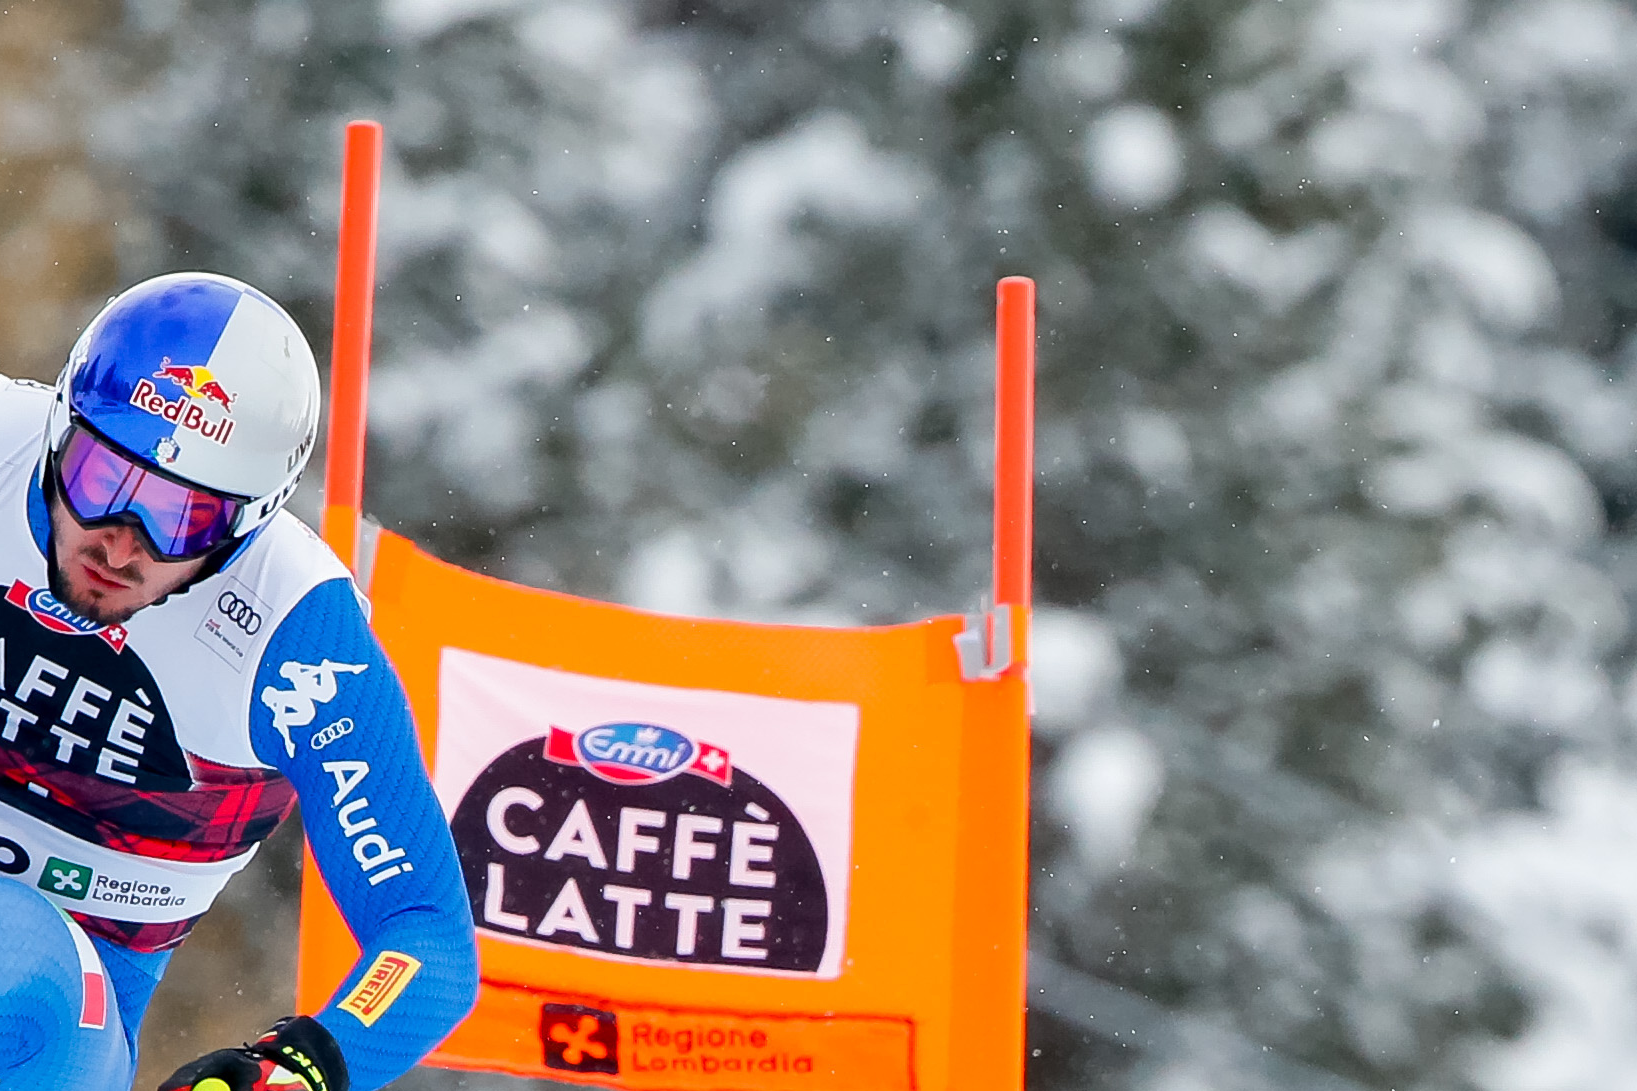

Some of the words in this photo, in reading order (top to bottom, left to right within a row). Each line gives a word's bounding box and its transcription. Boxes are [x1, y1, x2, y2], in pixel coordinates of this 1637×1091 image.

[131, 380, 187, 423] Red
[182, 403, 234, 446] Bull
[584, 725, 686, 770] Emmi
[322, 760, 413, 887] Audi
[486, 786, 781, 889] CAFFÈ
[92, 888, 186, 907] Lombardia
[96, 875, 171, 895] Regione
[484, 863, 772, 960] LATTE
[349, 957, 409, 1015] PIRELLI
[632, 1023, 768, 1053] Regione
[632, 1053, 813, 1074] Lombardia
